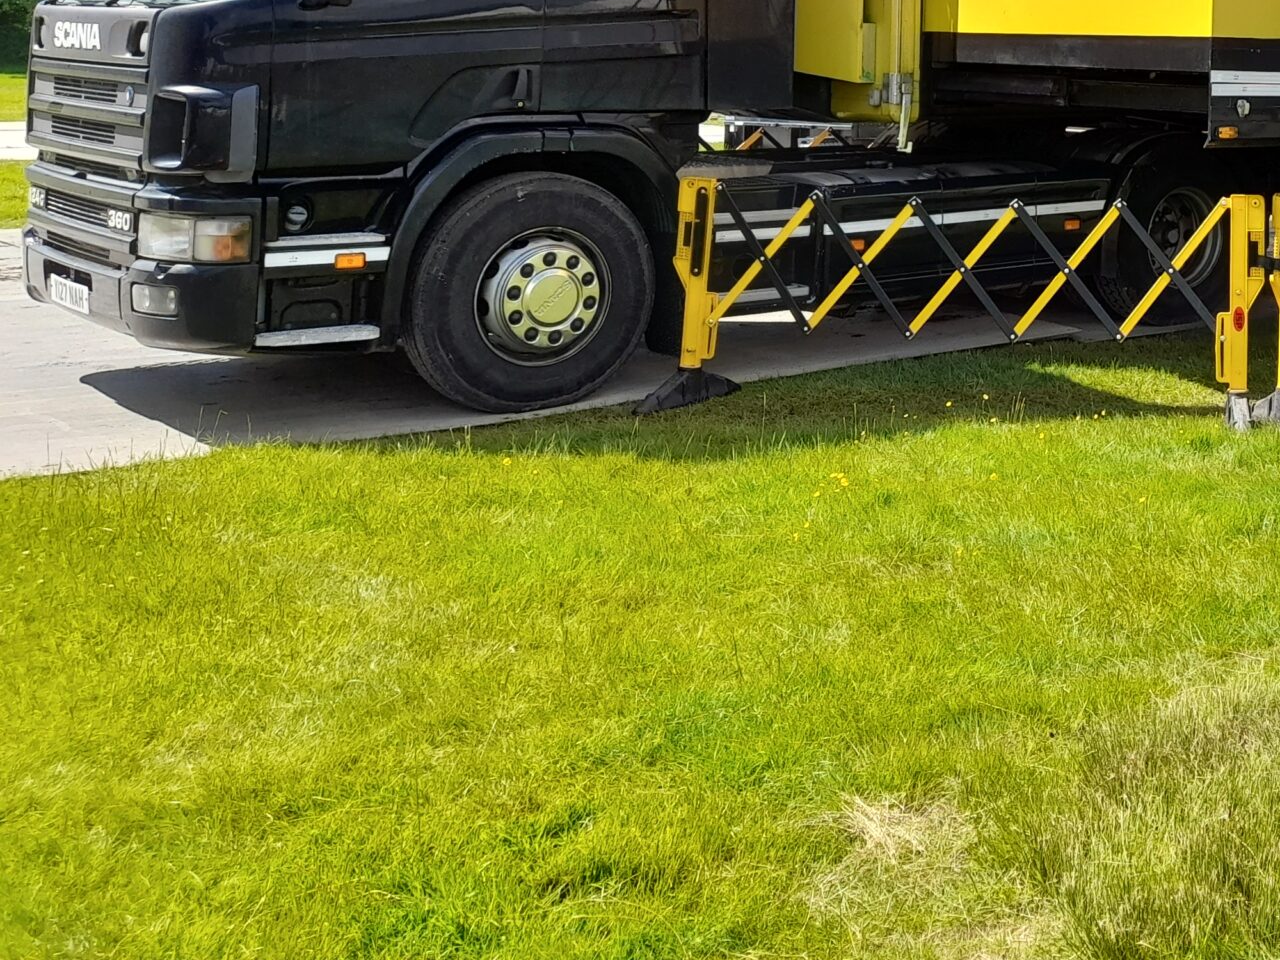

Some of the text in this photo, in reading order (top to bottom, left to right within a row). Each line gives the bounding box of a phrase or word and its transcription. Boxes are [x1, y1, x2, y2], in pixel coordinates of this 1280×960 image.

[53, 20, 101, 51] SCANIA
[108, 209, 131, 231] 360
[69, 284, 84, 309] NAH
